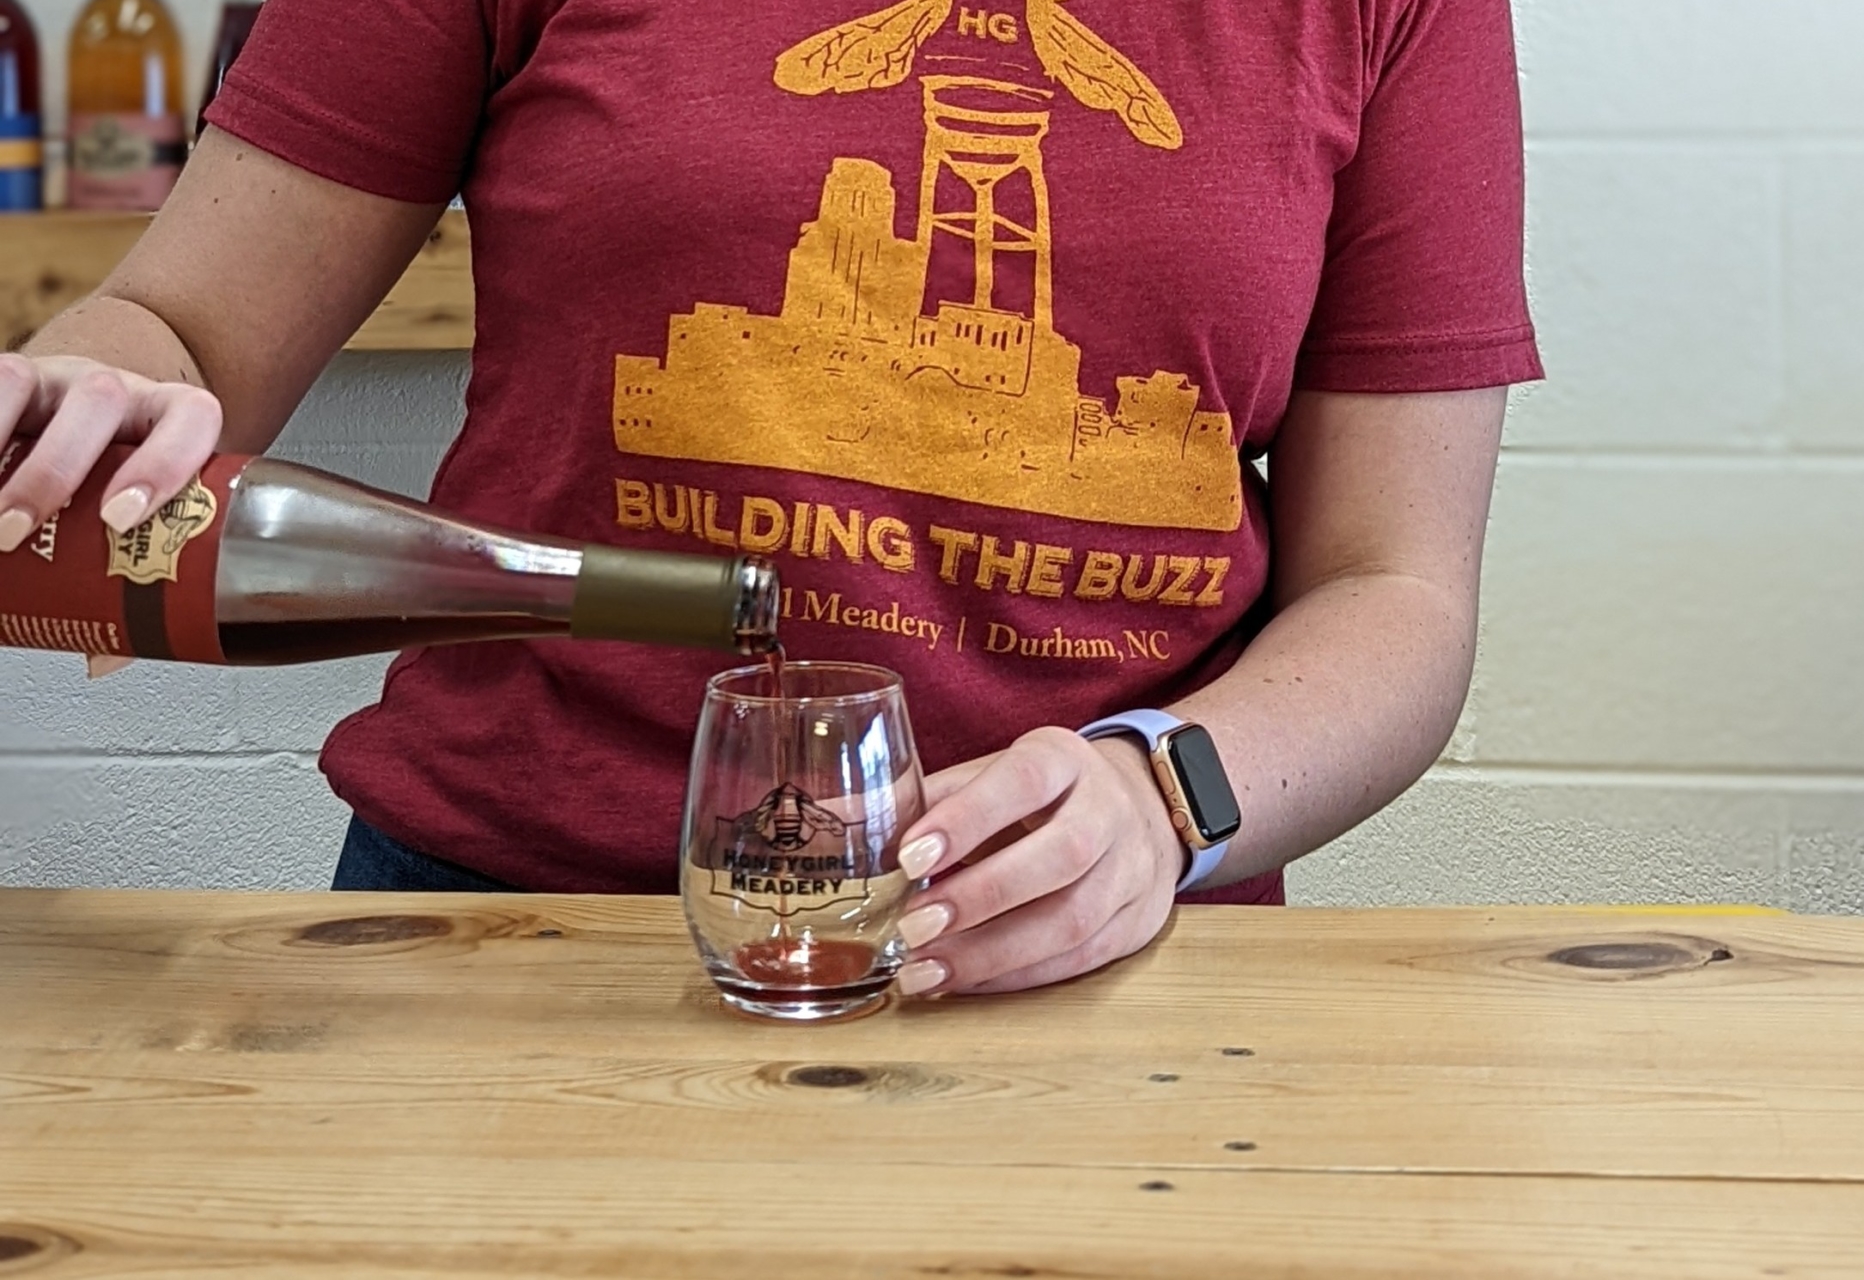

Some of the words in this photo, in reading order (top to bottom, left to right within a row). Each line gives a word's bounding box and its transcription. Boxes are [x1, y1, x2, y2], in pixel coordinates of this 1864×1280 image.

[957, 6, 1018, 44] HG
[132, 513, 153, 567] GIRL
[614, 478, 915, 573] BUILDING
[929, 524, 1073, 599] THE
[1074, 549, 1230, 607] BUZZ
[803, 589, 944, 651] Meadery
[723, 848, 853, 872] HONEYGIRL
[730, 872, 844, 896] MEADERY
